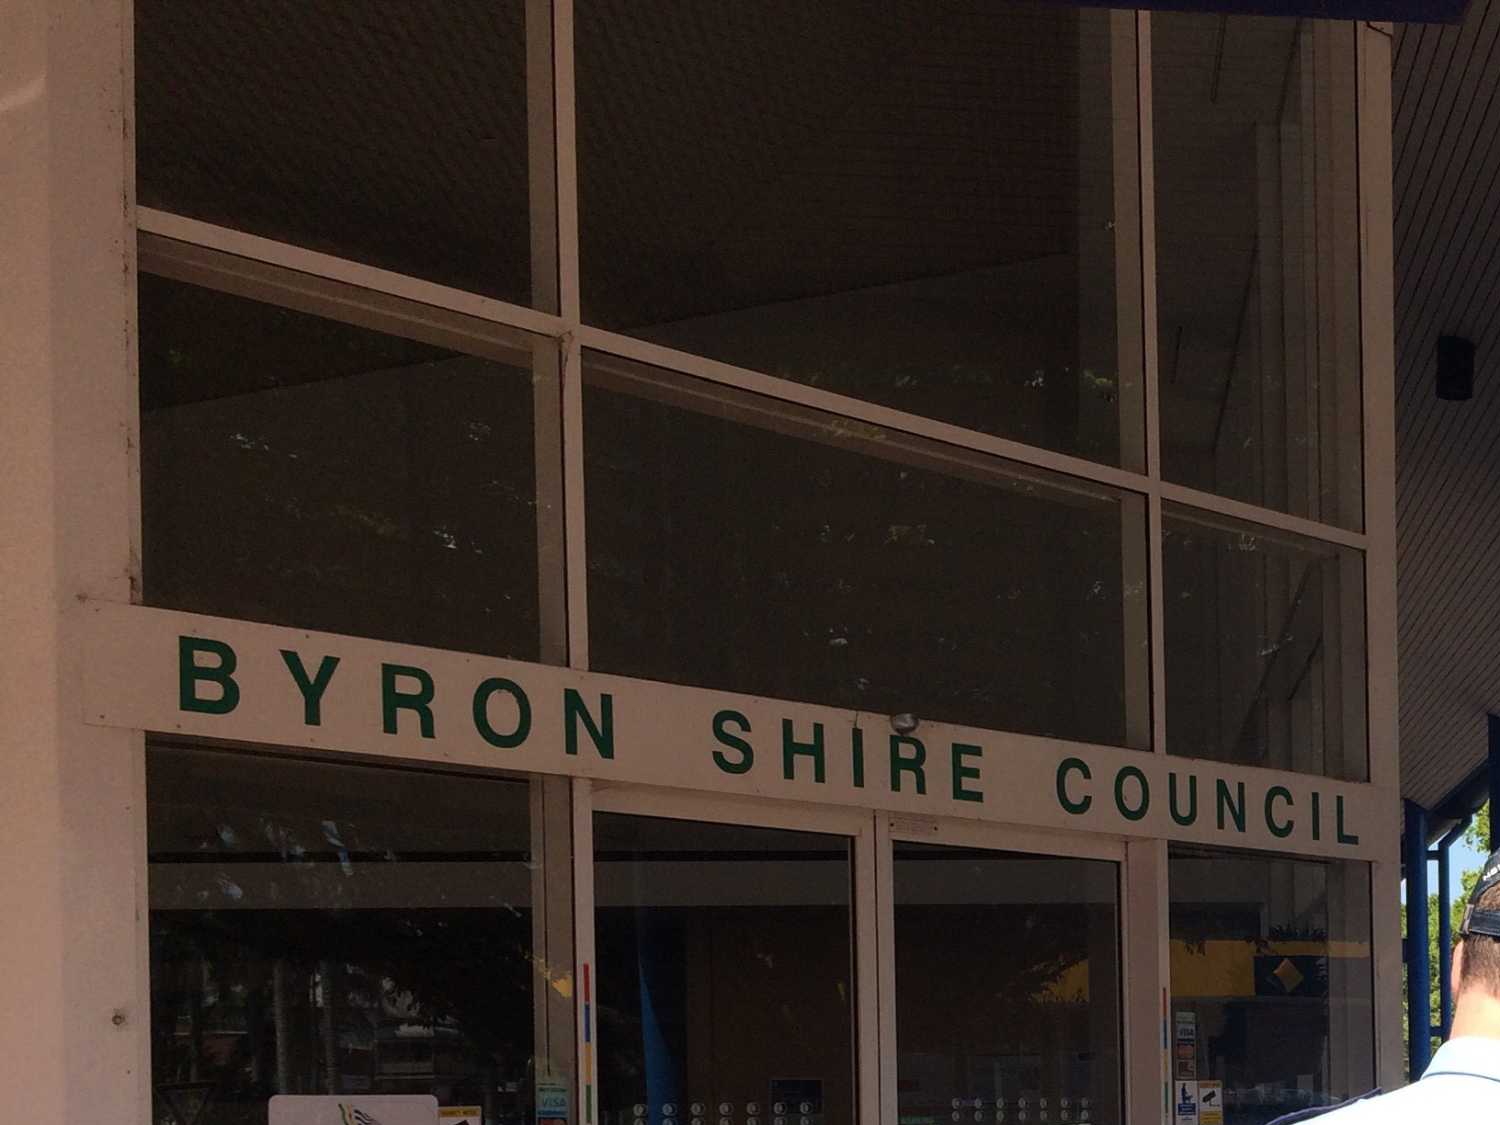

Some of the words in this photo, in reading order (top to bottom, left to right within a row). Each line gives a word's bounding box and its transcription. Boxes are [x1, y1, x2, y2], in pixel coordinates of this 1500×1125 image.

[179, 636, 616, 760] BYRON
[712, 709, 983, 802] SHIRE
[1056, 757, 1360, 845] COUNCIL
